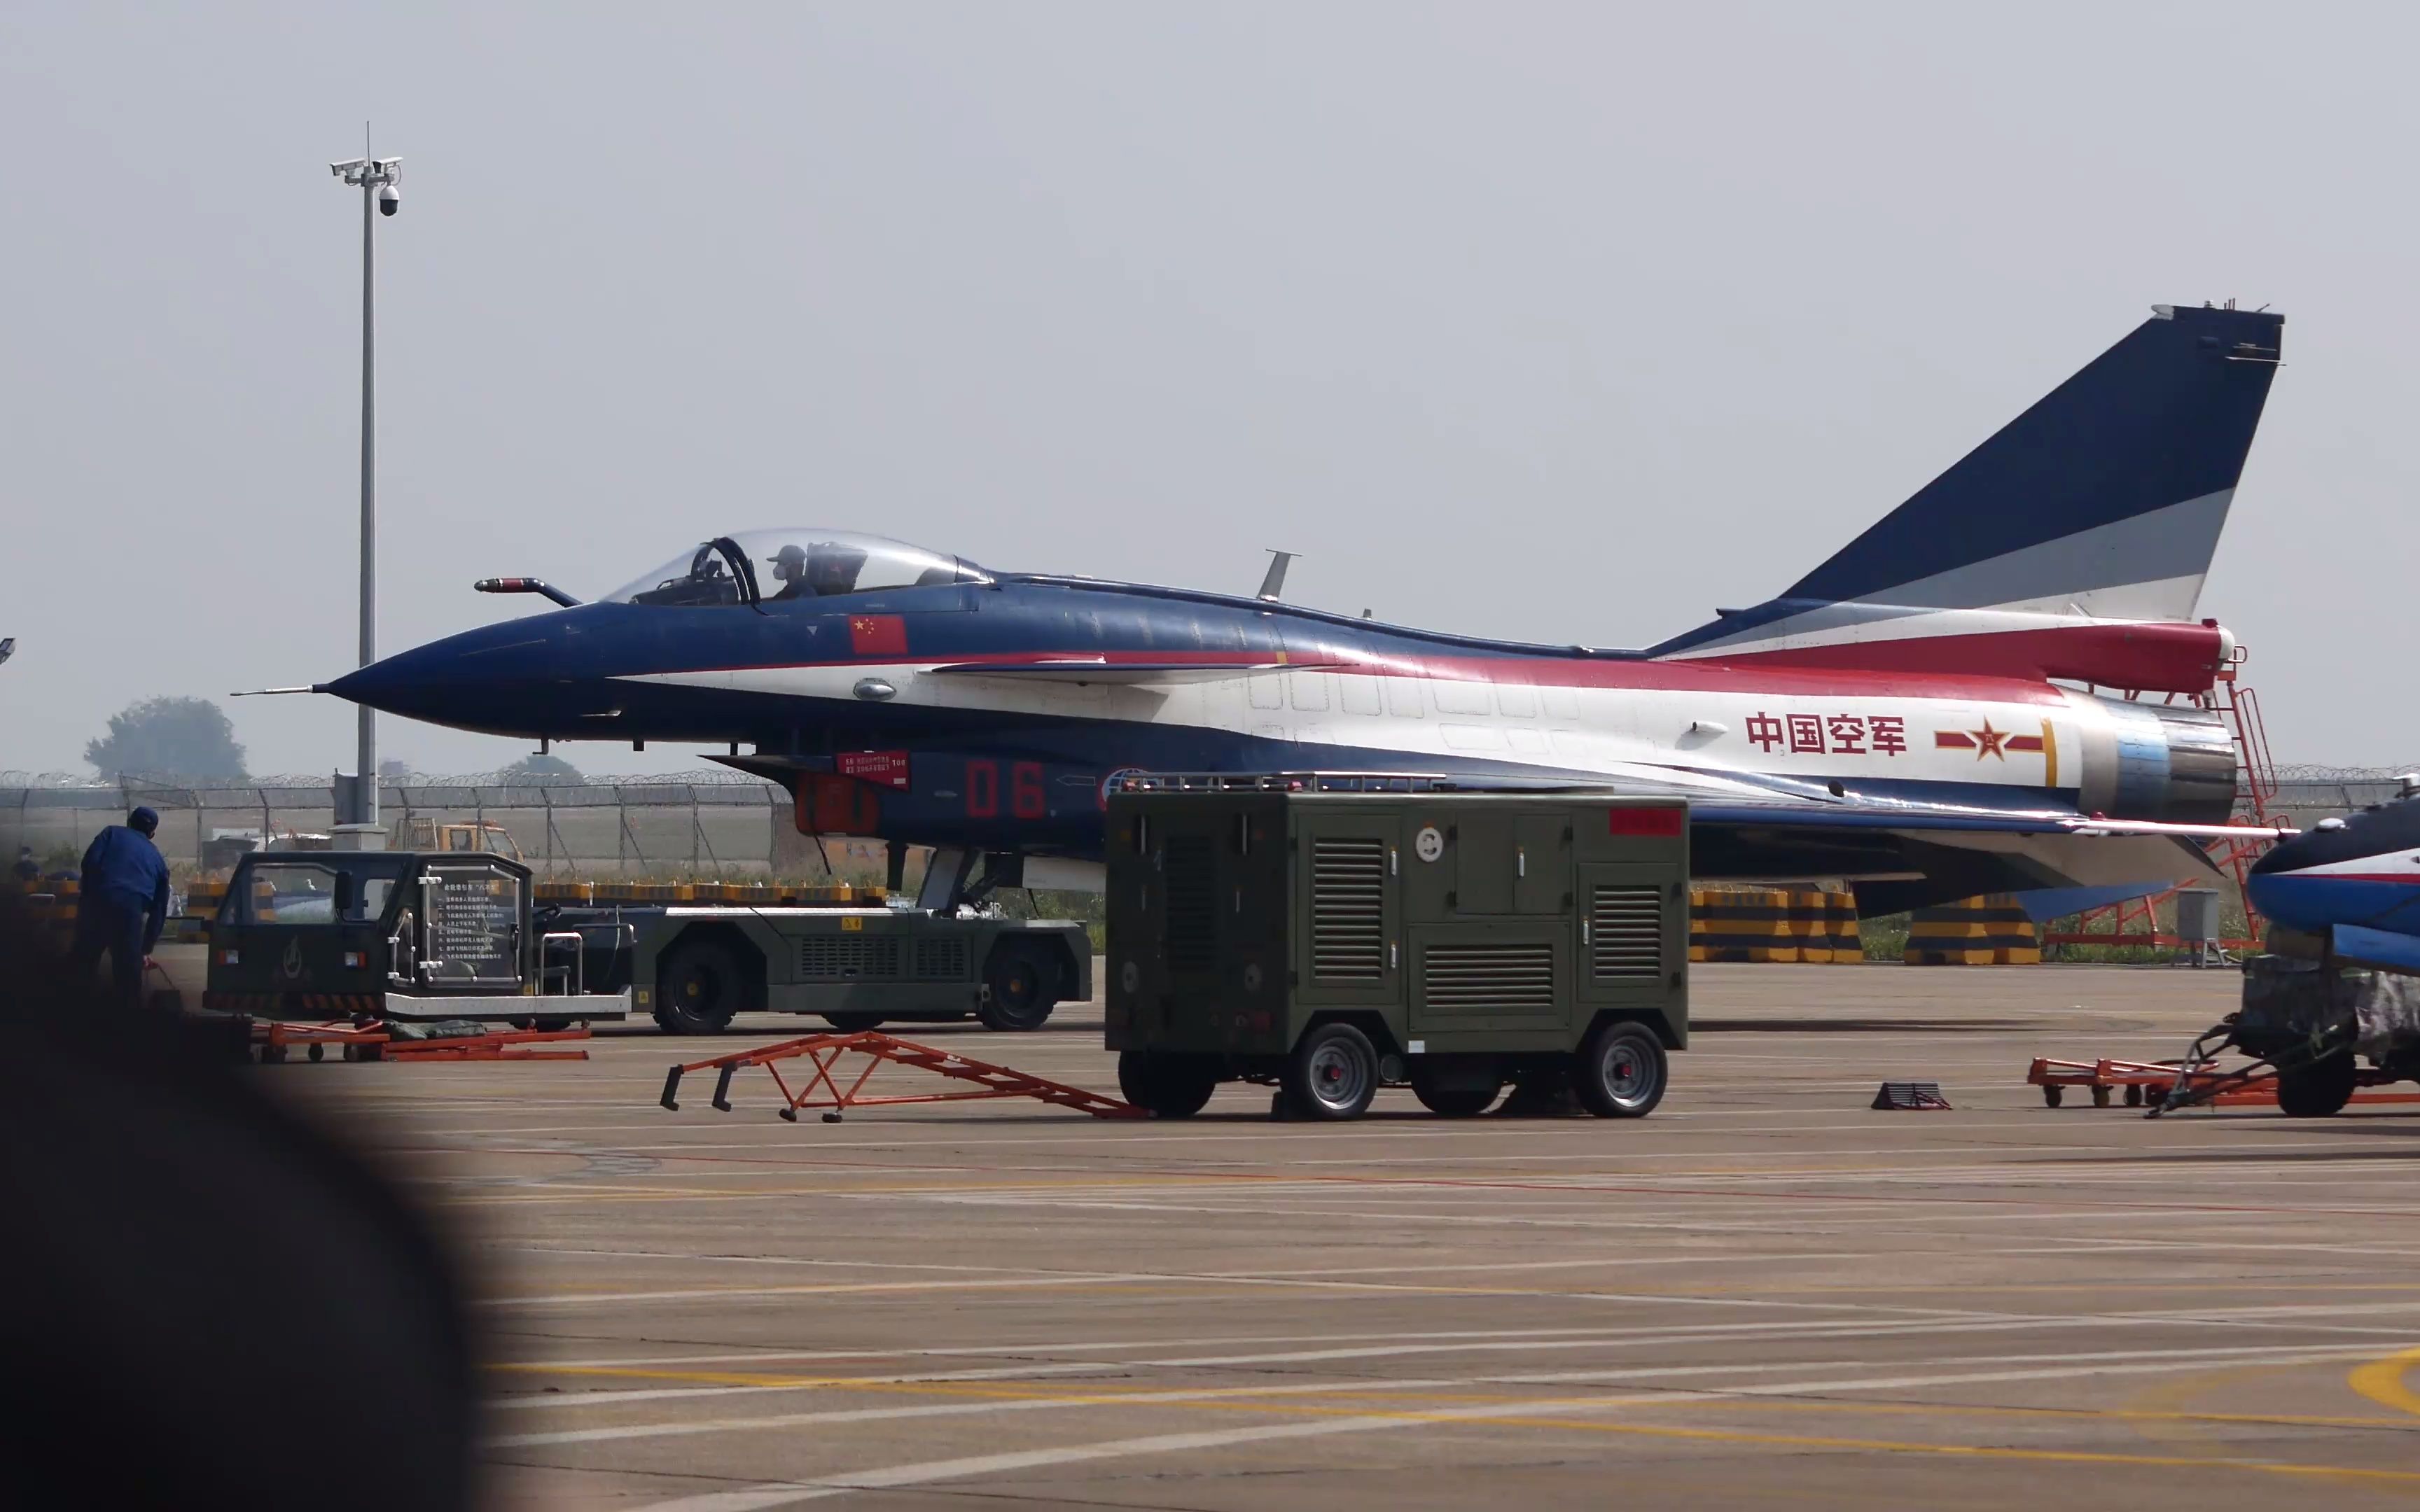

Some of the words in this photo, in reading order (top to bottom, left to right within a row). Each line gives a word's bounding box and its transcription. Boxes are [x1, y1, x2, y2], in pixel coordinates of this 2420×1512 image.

[1746, 711, 1907, 757] 中国空军
[966, 760, 1043, 818] 06
